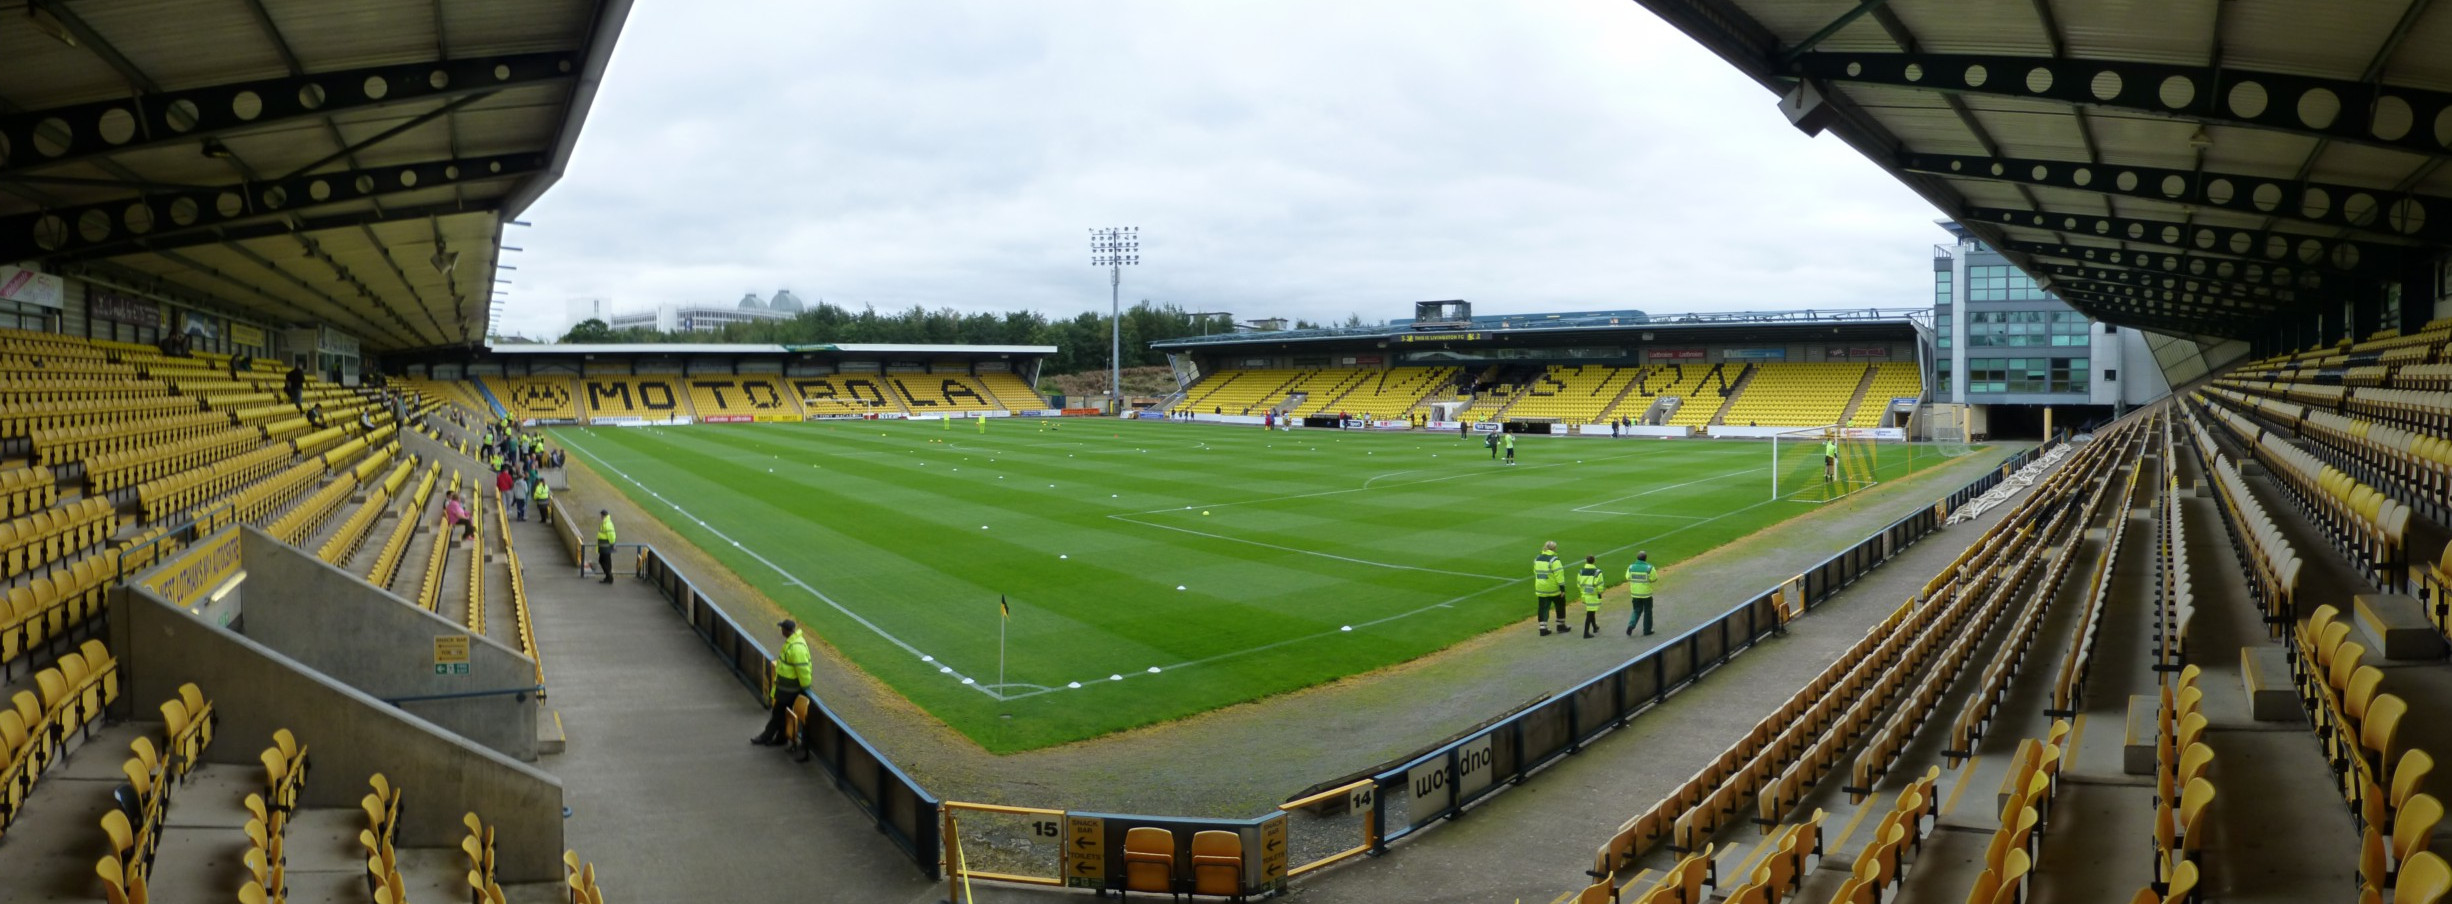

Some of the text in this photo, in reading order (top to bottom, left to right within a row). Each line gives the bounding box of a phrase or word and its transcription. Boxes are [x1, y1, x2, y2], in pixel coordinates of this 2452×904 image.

[586, 379, 988, 410] MOTOROLA
[1353, 790, 1372, 809] 14
[1032, 821, 1058, 837] 15
[1263, 820, 1283, 830] SNACK
[1267, 828, 1280, 836] BAR
[1070, 852, 1102, 860] TOILETS
[1263, 852, 1285, 863] TOILETS
